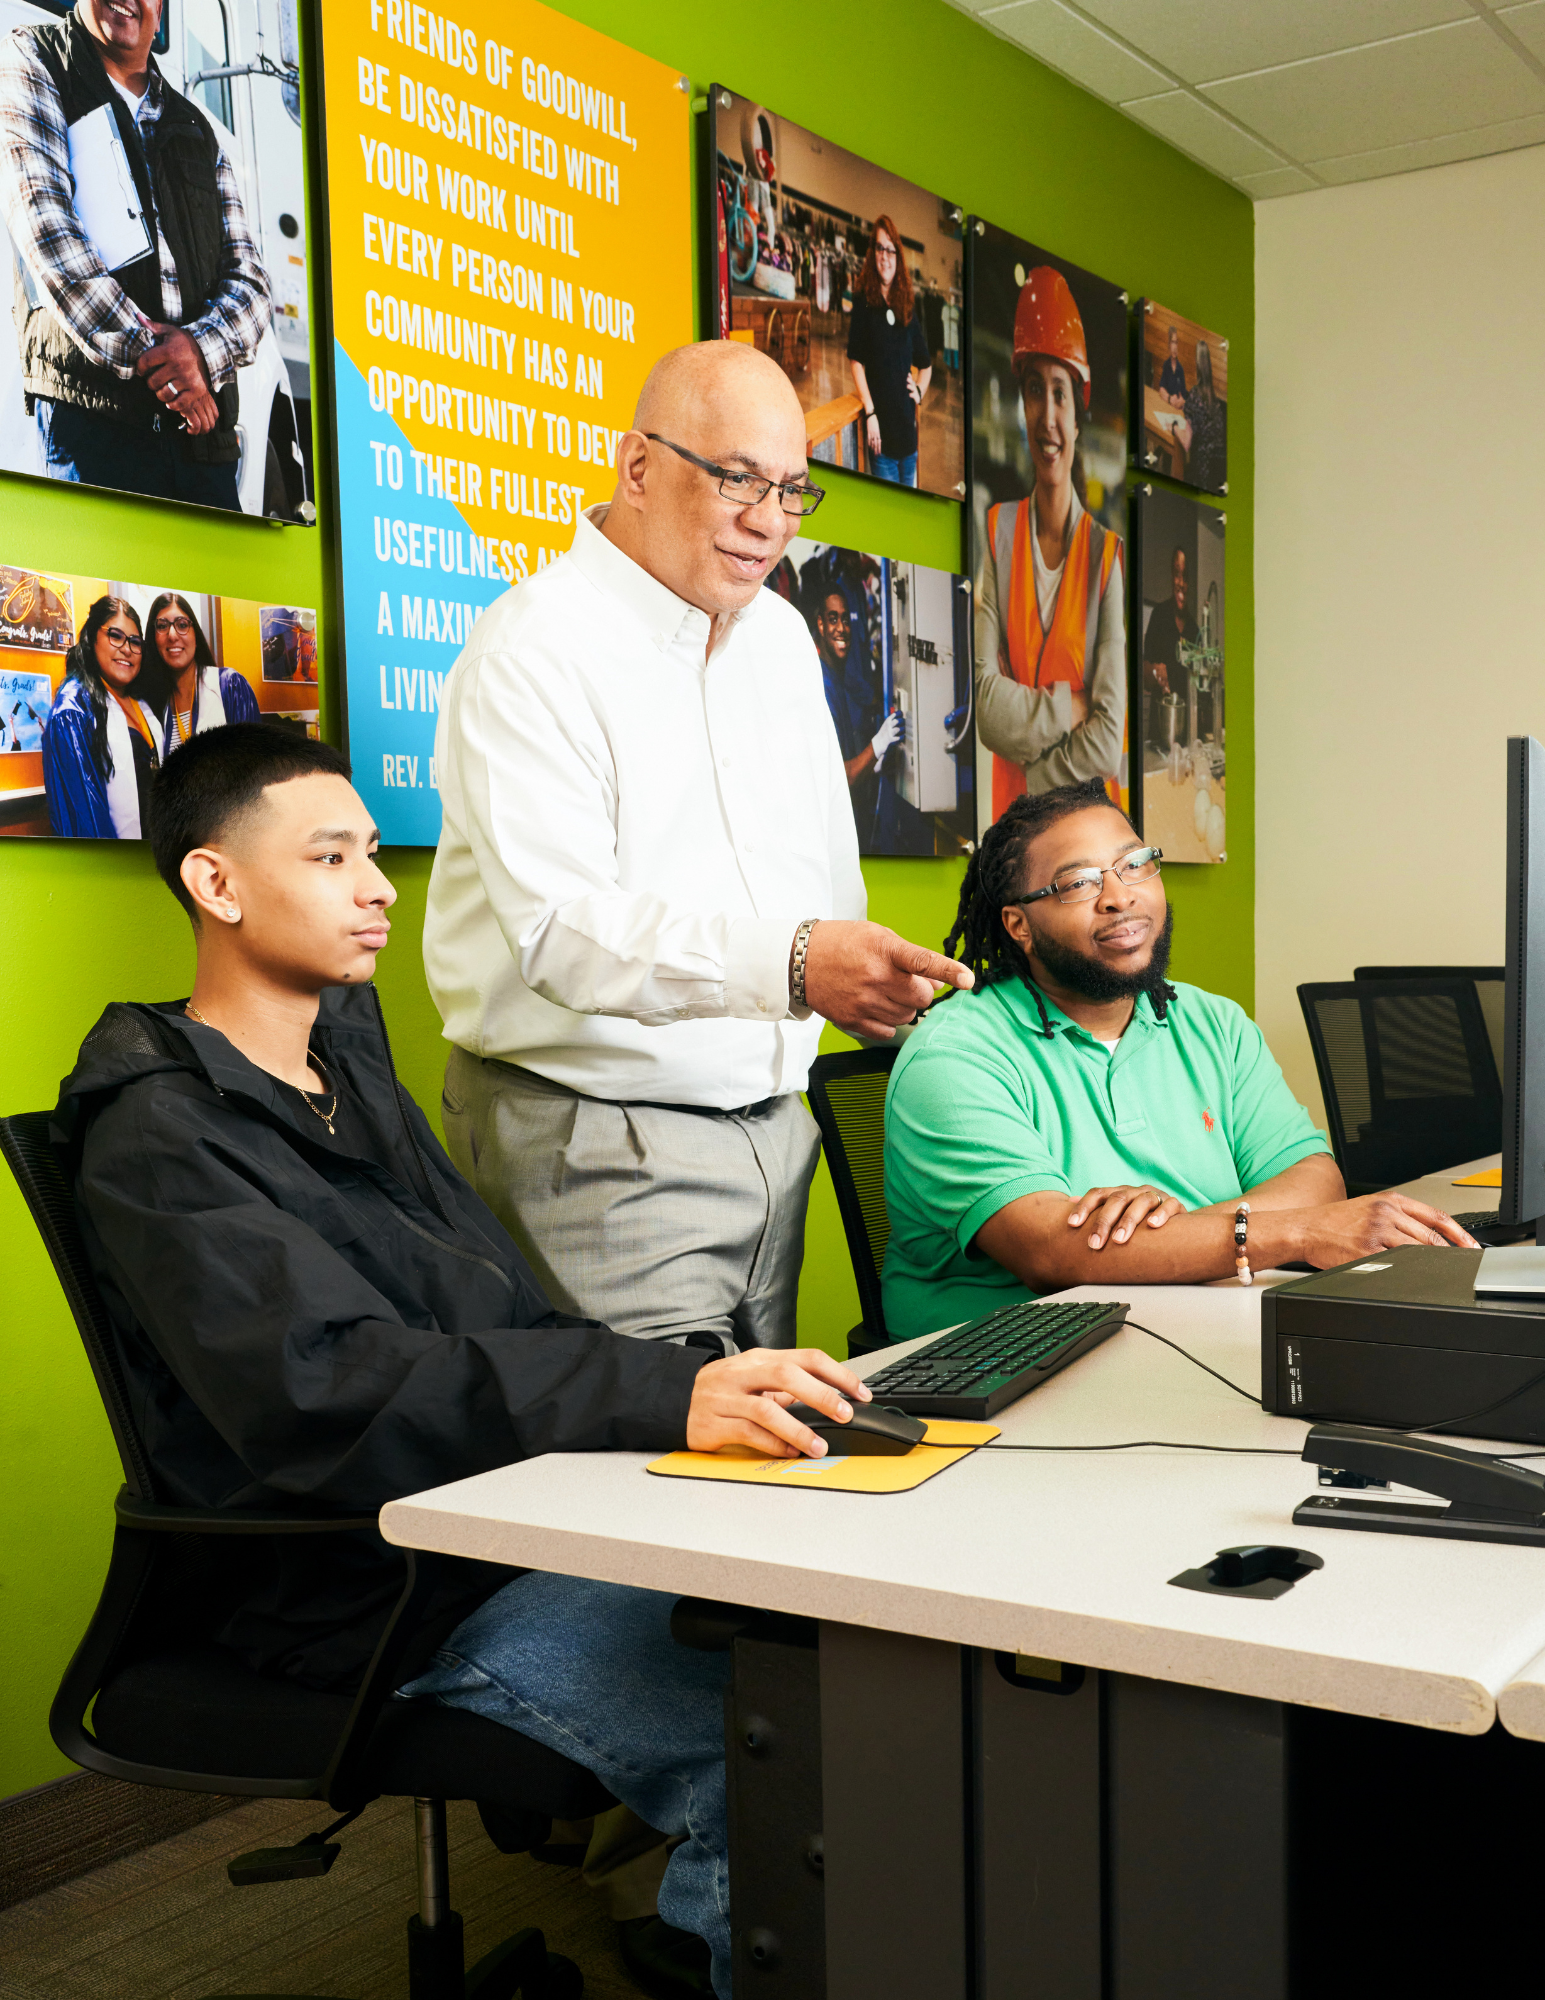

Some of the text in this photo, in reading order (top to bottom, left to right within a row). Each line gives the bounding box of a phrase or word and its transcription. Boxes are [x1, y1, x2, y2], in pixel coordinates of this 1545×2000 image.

[370, 0, 637, 152] FRIENDS OF GOODWILL,
[358, 55, 620, 206] BE DISSATISFIED WITH
[359, 133, 580, 259] YOUR WORK UNTIL
[363, 212, 636, 344] EVERY PERSON IN YOUR
[365, 289, 603, 400] COMMUNITY HAS AN
[367, 365, 626, 469] OPPORTUNITY TO DEV
[369, 440, 586, 526] TO THEIR FULLEST
[373, 515, 530, 585] USEFULNESS
[377, 591, 490, 646] A MAXIM
[379, 664, 448, 714] LIVIN
[382, 753, 424, 789] REV.
